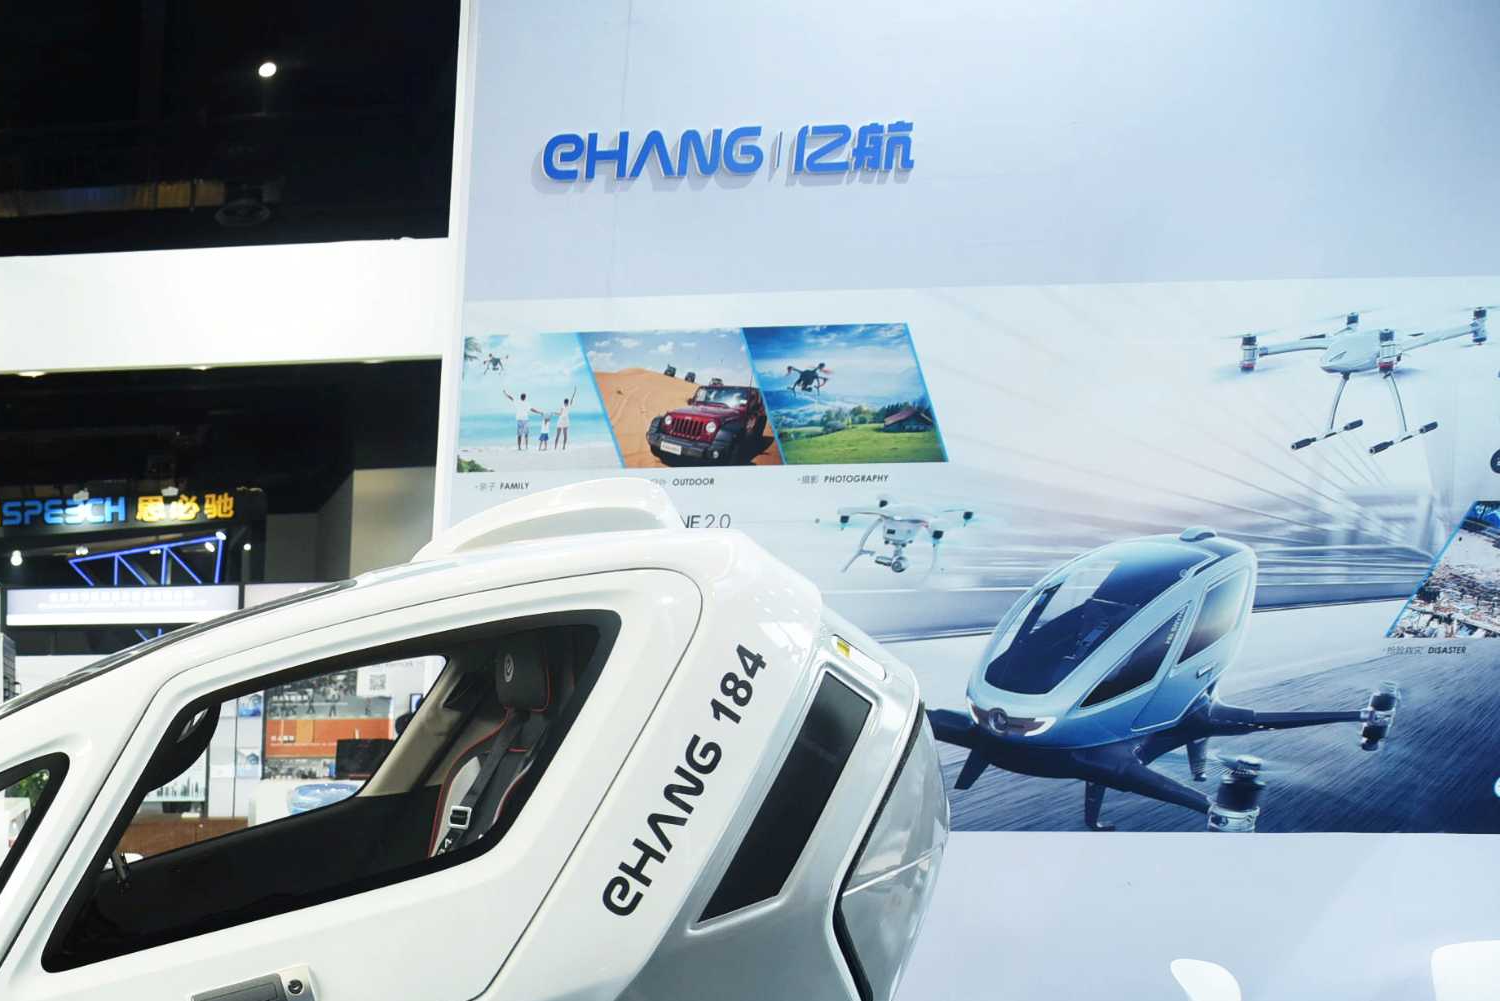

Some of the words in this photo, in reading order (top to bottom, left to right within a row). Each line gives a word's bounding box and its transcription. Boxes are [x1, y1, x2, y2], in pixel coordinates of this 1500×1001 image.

[793, 121, 914, 175] 亿航
[672, 478, 715, 487] OUTDOOR
[823, 474, 889, 483] PHOTOGRAPHY
[500, 482, 529, 490] FAMILY
[1428, 646, 1467, 654] DISASTER
[710, 644, 766, 724] 184
